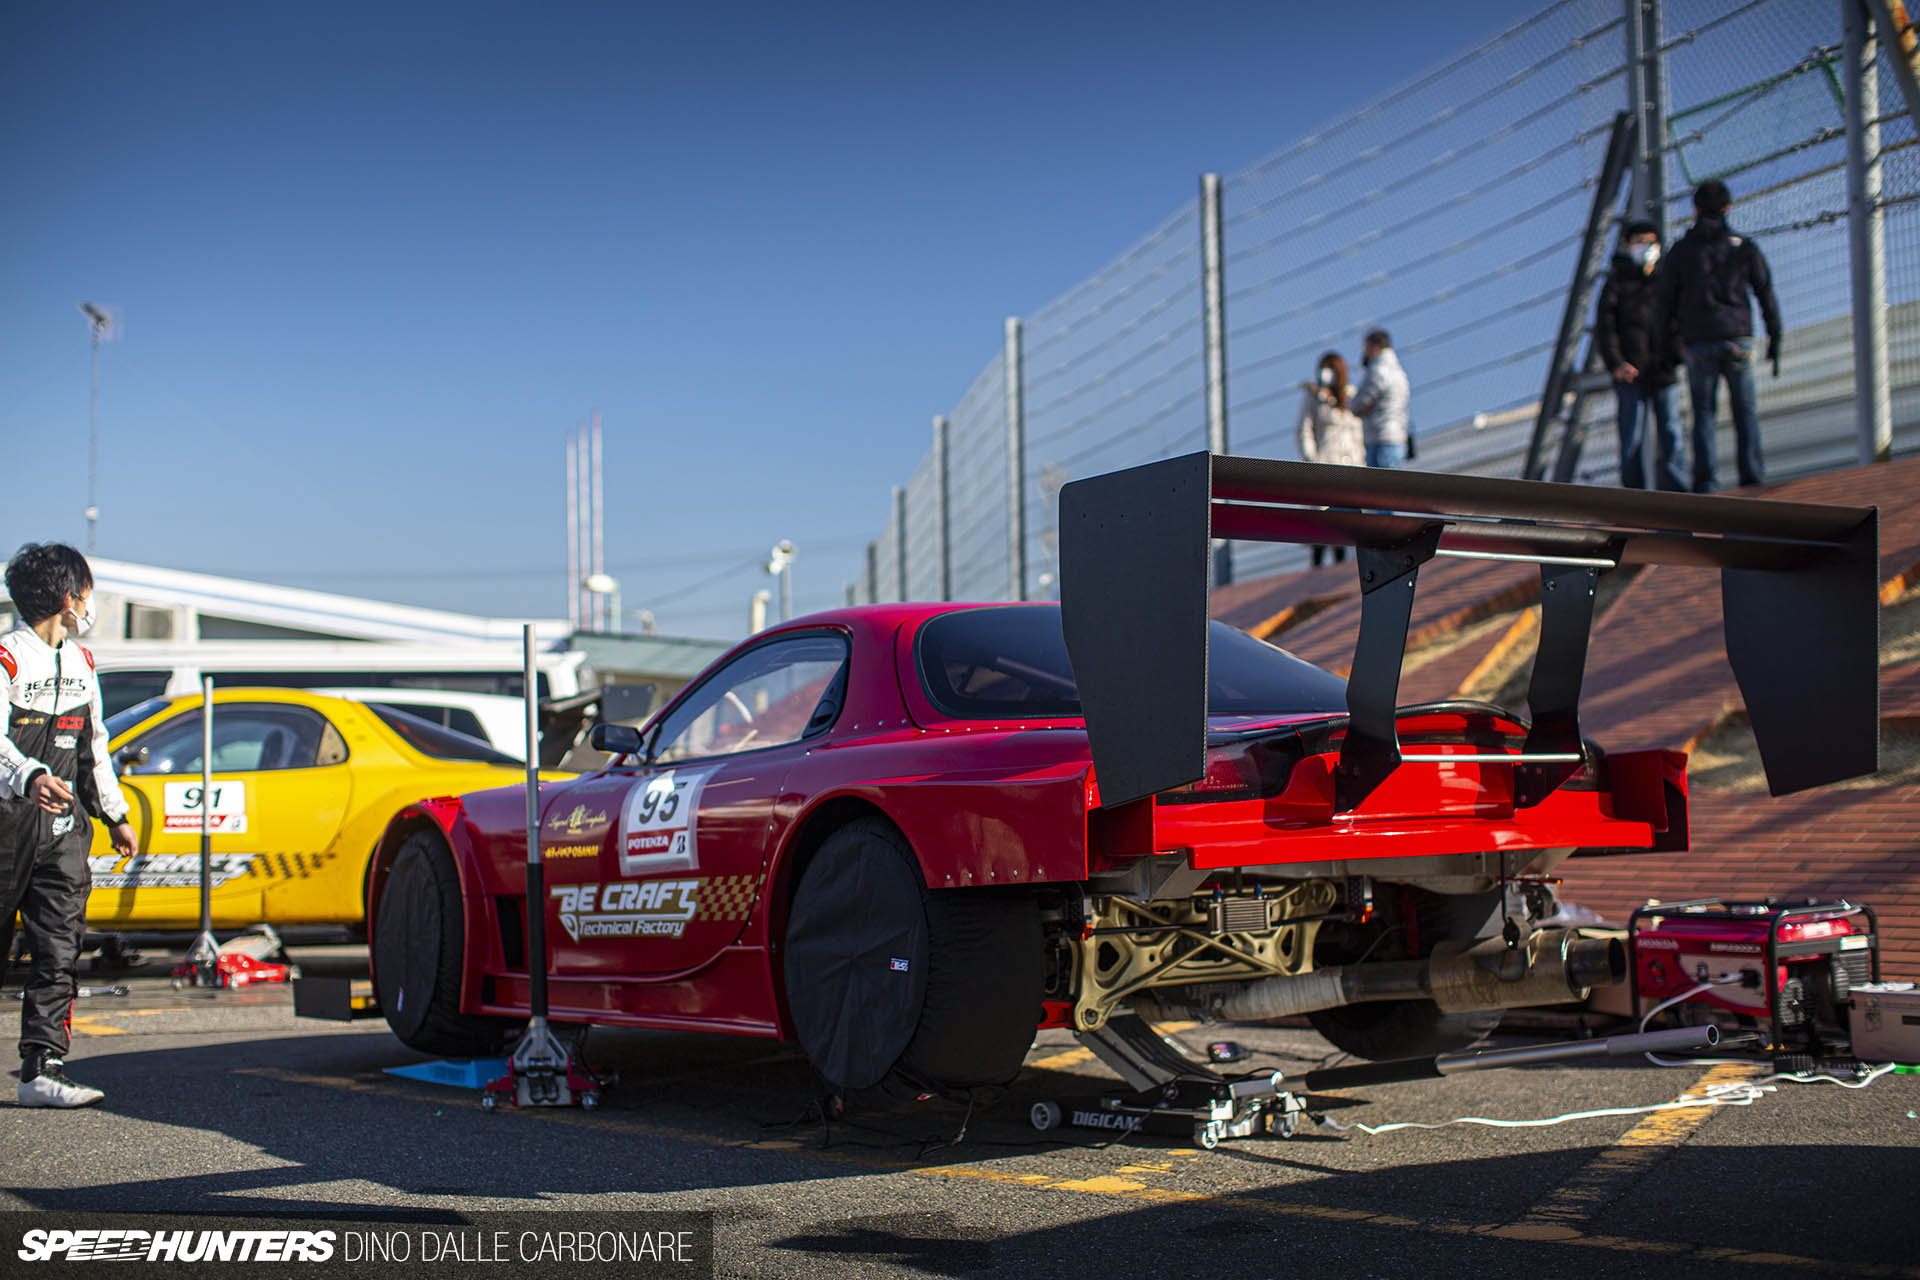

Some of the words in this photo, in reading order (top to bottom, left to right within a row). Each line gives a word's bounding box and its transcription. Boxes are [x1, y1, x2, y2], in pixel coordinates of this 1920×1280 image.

[183, 787, 222, 808] 91
[639, 781, 688, 824] 95
[628, 834, 669, 850] POTENZA
[551, 884, 598, 912] BE
[601, 881, 699, 920] CRAFT
[580, 920, 633, 936] Technical
[636, 919, 685, 937] Factory
